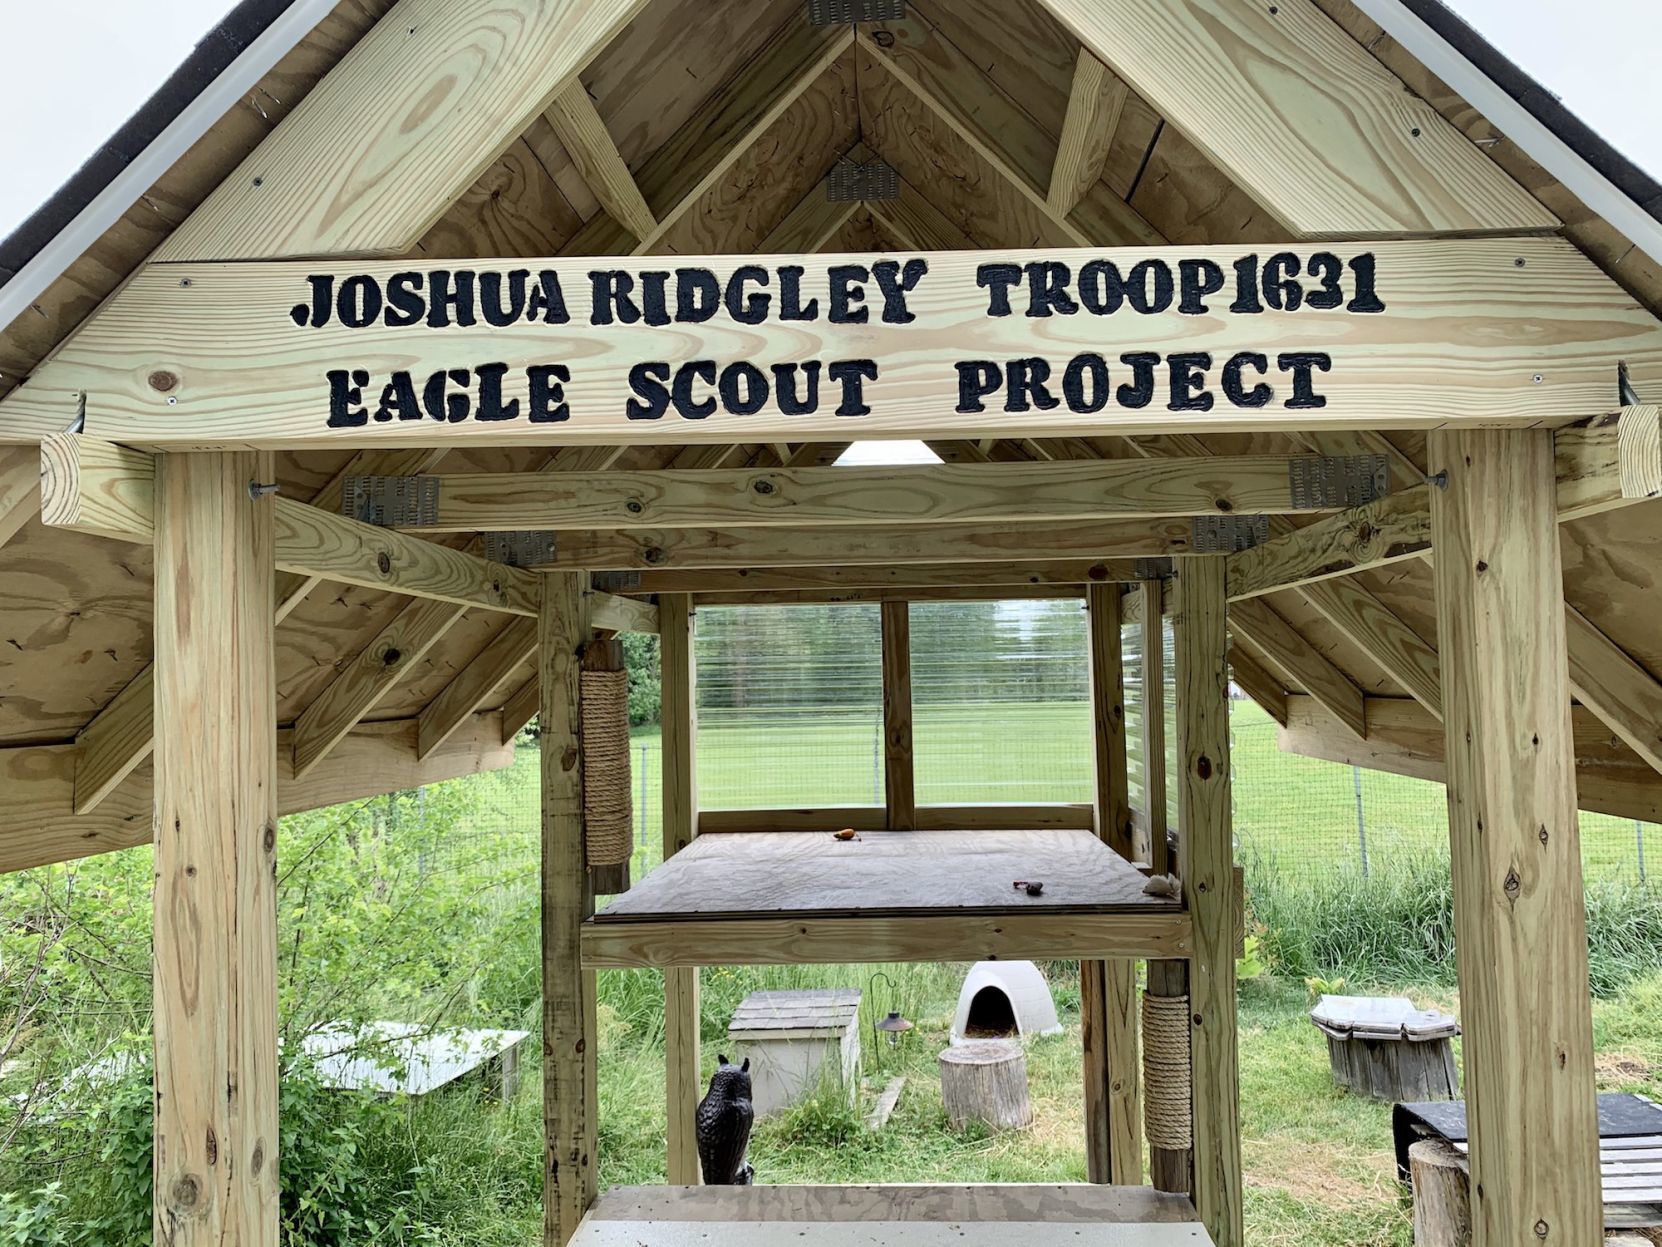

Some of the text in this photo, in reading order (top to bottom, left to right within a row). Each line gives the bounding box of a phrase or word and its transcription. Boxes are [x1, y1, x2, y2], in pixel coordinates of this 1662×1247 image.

[289, 268, 571, 330] JOSHUA
[588, 258, 929, 327] RIDGLEY
[325, 350, 1333, 429] EAGLE SCOUT PROJECT
